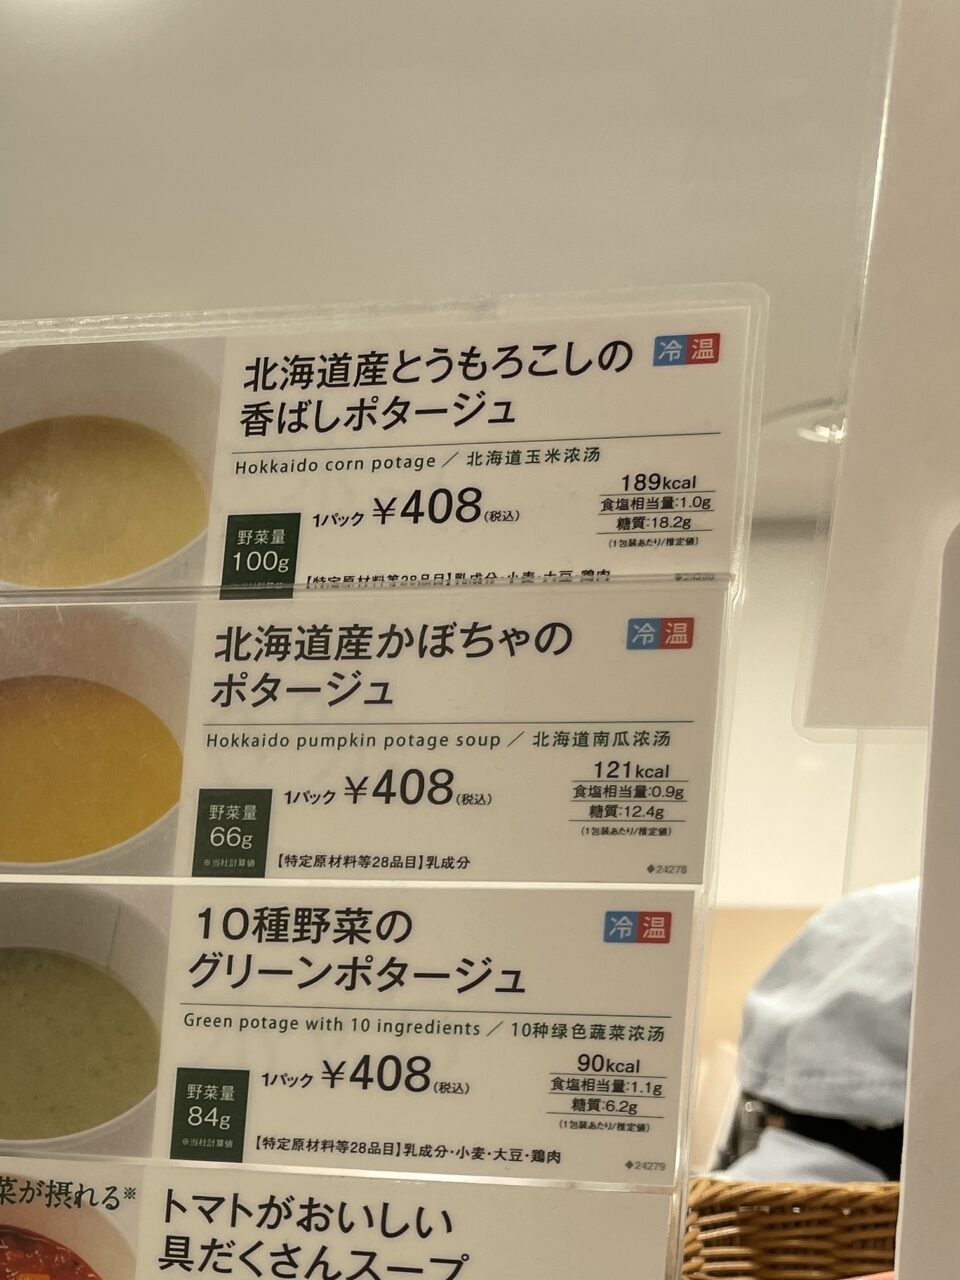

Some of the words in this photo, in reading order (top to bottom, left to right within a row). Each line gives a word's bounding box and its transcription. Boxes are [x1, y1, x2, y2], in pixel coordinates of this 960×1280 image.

[242, 339, 634, 393] 北海道産とうもろこしの
[239, 389, 516, 438] 香ばしポタージュ
[235, 457, 319, 475] Hokkaido
[324, 460, 365, 473] corn
[371, 454, 437, 473] potage
[466, 446, 601, 467] 北海道玉米浓汤
[620, 472, 697, 492] 189kcal
[312, 511, 365, 528] 1パック
[235, 528, 287, 547] 野菜量
[232, 550, 290, 574] 100g
[213, 620, 574, 663] 北海道産かぼちゃの
[209, 669, 394, 709] ポタージュ
[205, 731, 290, 748] Hokkaido
[296, 731, 377, 751] pumpkin
[383, 733, 450, 751] potage
[455, 733, 502, 751] soup
[532, 729, 672, 748] 北海道南瓜浓汤
[593, 760, 670, 780] 121kcal
[283, 789, 337, 806] 1パック
[207, 803, 258, 822] 野菜量
[209, 825, 254, 850] 66g
[197, 905, 413, 945] 10種野菜の
[187, 950, 526, 995] グリーンポタージュ
[183, 1012, 233, 1029] Green
[238, 1014, 299, 1034] potage
[305, 1016, 344, 1032] with
[350, 1017, 371, 1033] 10
[376, 1018, 481, 1037] ingredients
[510, 1021, 666, 1043] 10种绿色蔬菜浓汤
[576, 1053, 641, 1075] 90kcal
[185, 1082, 236, 1103] 野菜量
[261, 1072, 314, 1089] 1パック
[186, 1104, 232, 1131] 84g
[164, 1187, 453, 1239] トマトがおいしい
